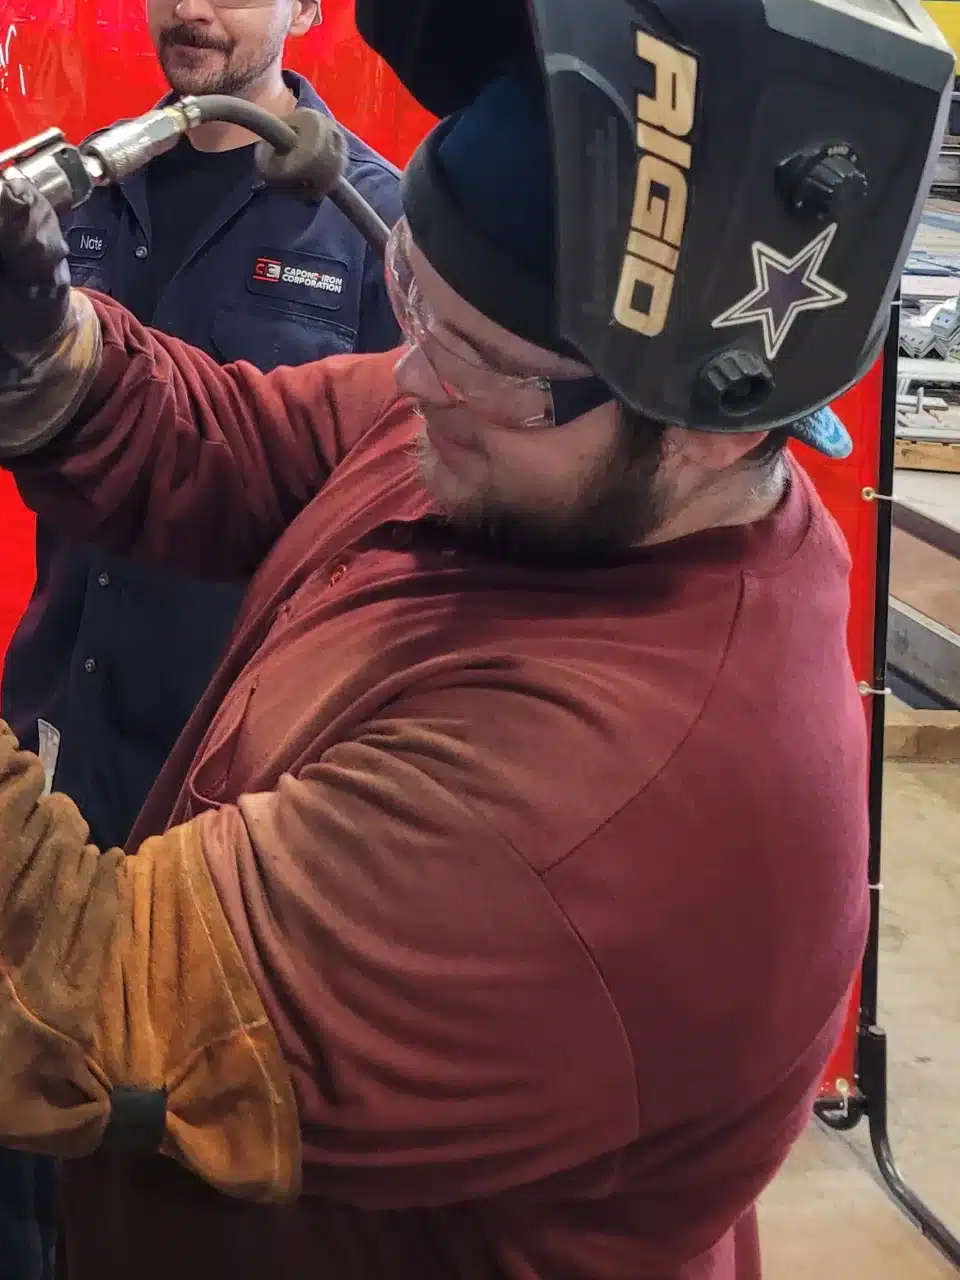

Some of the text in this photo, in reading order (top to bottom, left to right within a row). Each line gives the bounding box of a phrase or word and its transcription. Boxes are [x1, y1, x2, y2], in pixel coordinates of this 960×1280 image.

[614, 29, 698, 337] RIGID
[80, 234, 103, 251] Nate
[282, 273, 343, 294] CORPORATION
